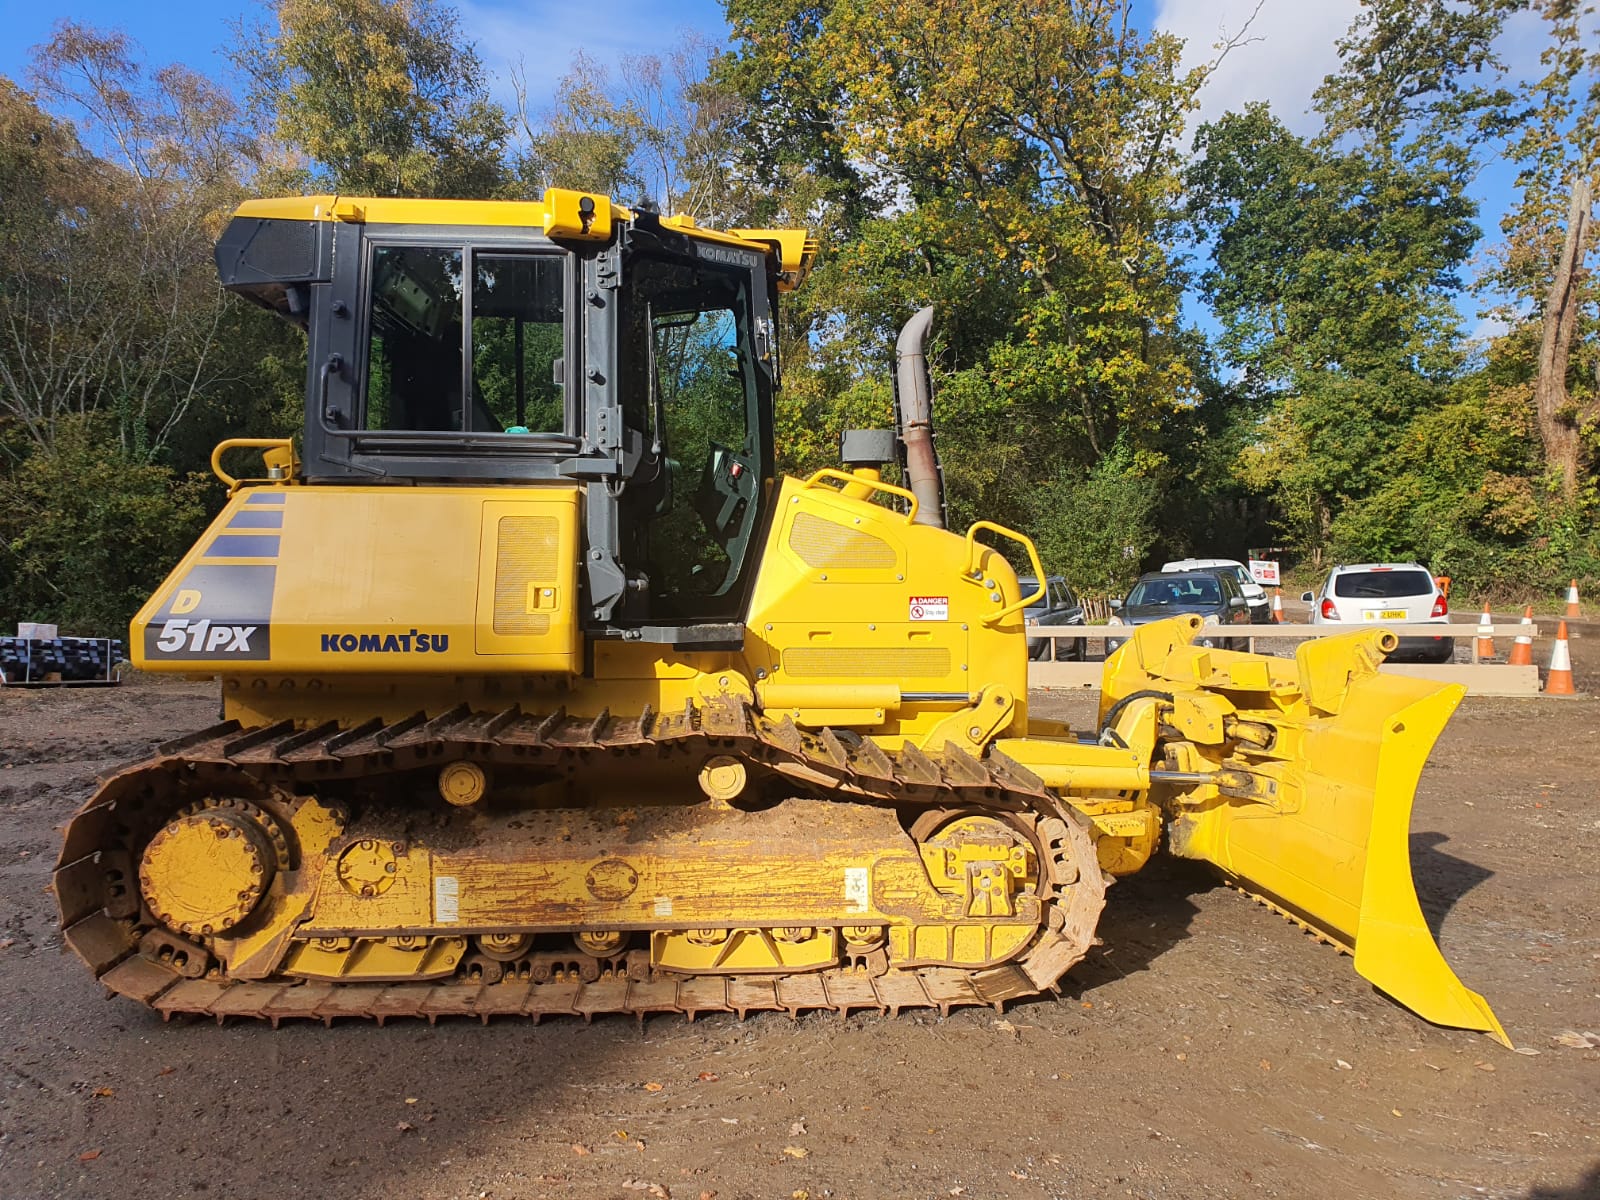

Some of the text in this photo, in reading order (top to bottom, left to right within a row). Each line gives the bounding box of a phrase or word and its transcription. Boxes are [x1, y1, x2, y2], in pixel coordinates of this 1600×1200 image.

[696, 246, 758, 267] KOMATSU
[169, 589, 202, 615] D
[156, 618, 258, 652] 51PX
[321, 629, 449, 652] KOMATSU
